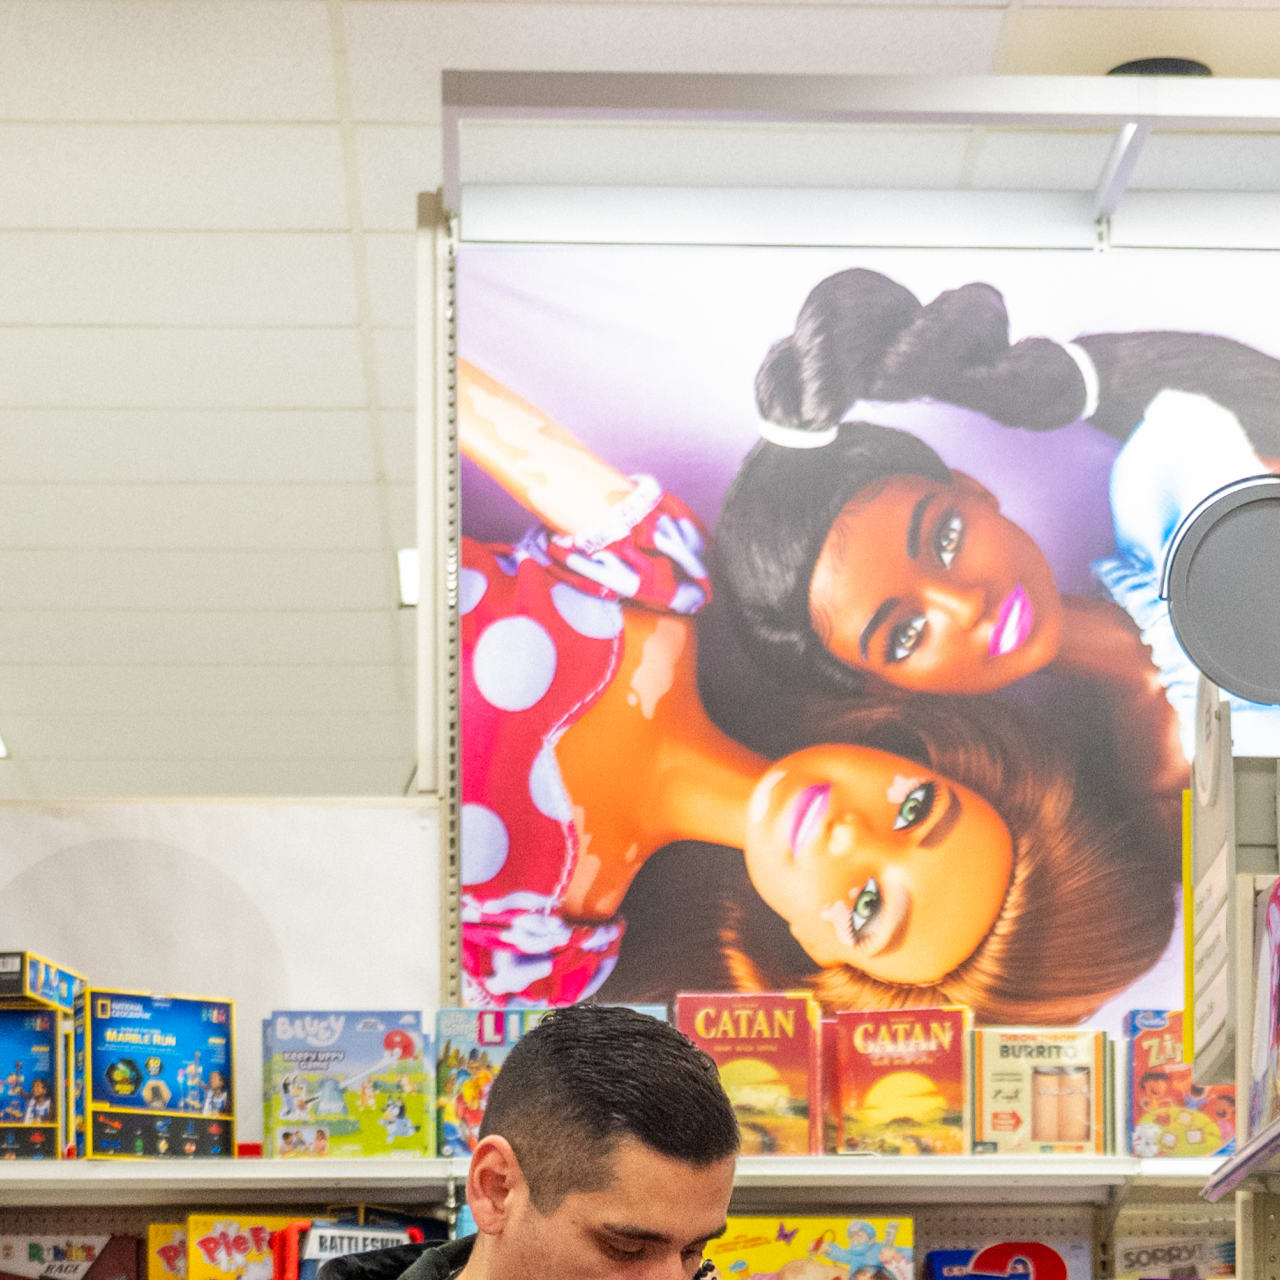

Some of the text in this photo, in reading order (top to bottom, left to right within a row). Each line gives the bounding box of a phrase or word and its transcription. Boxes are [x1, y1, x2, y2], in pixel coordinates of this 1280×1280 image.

[695, 1007, 795, 1040] CATAN
[853, 1018, 954, 1054] CATAN
[105, 1030, 176, 1047] MARBLE RUN
[999, 1044, 1078, 1060] BURRITO
